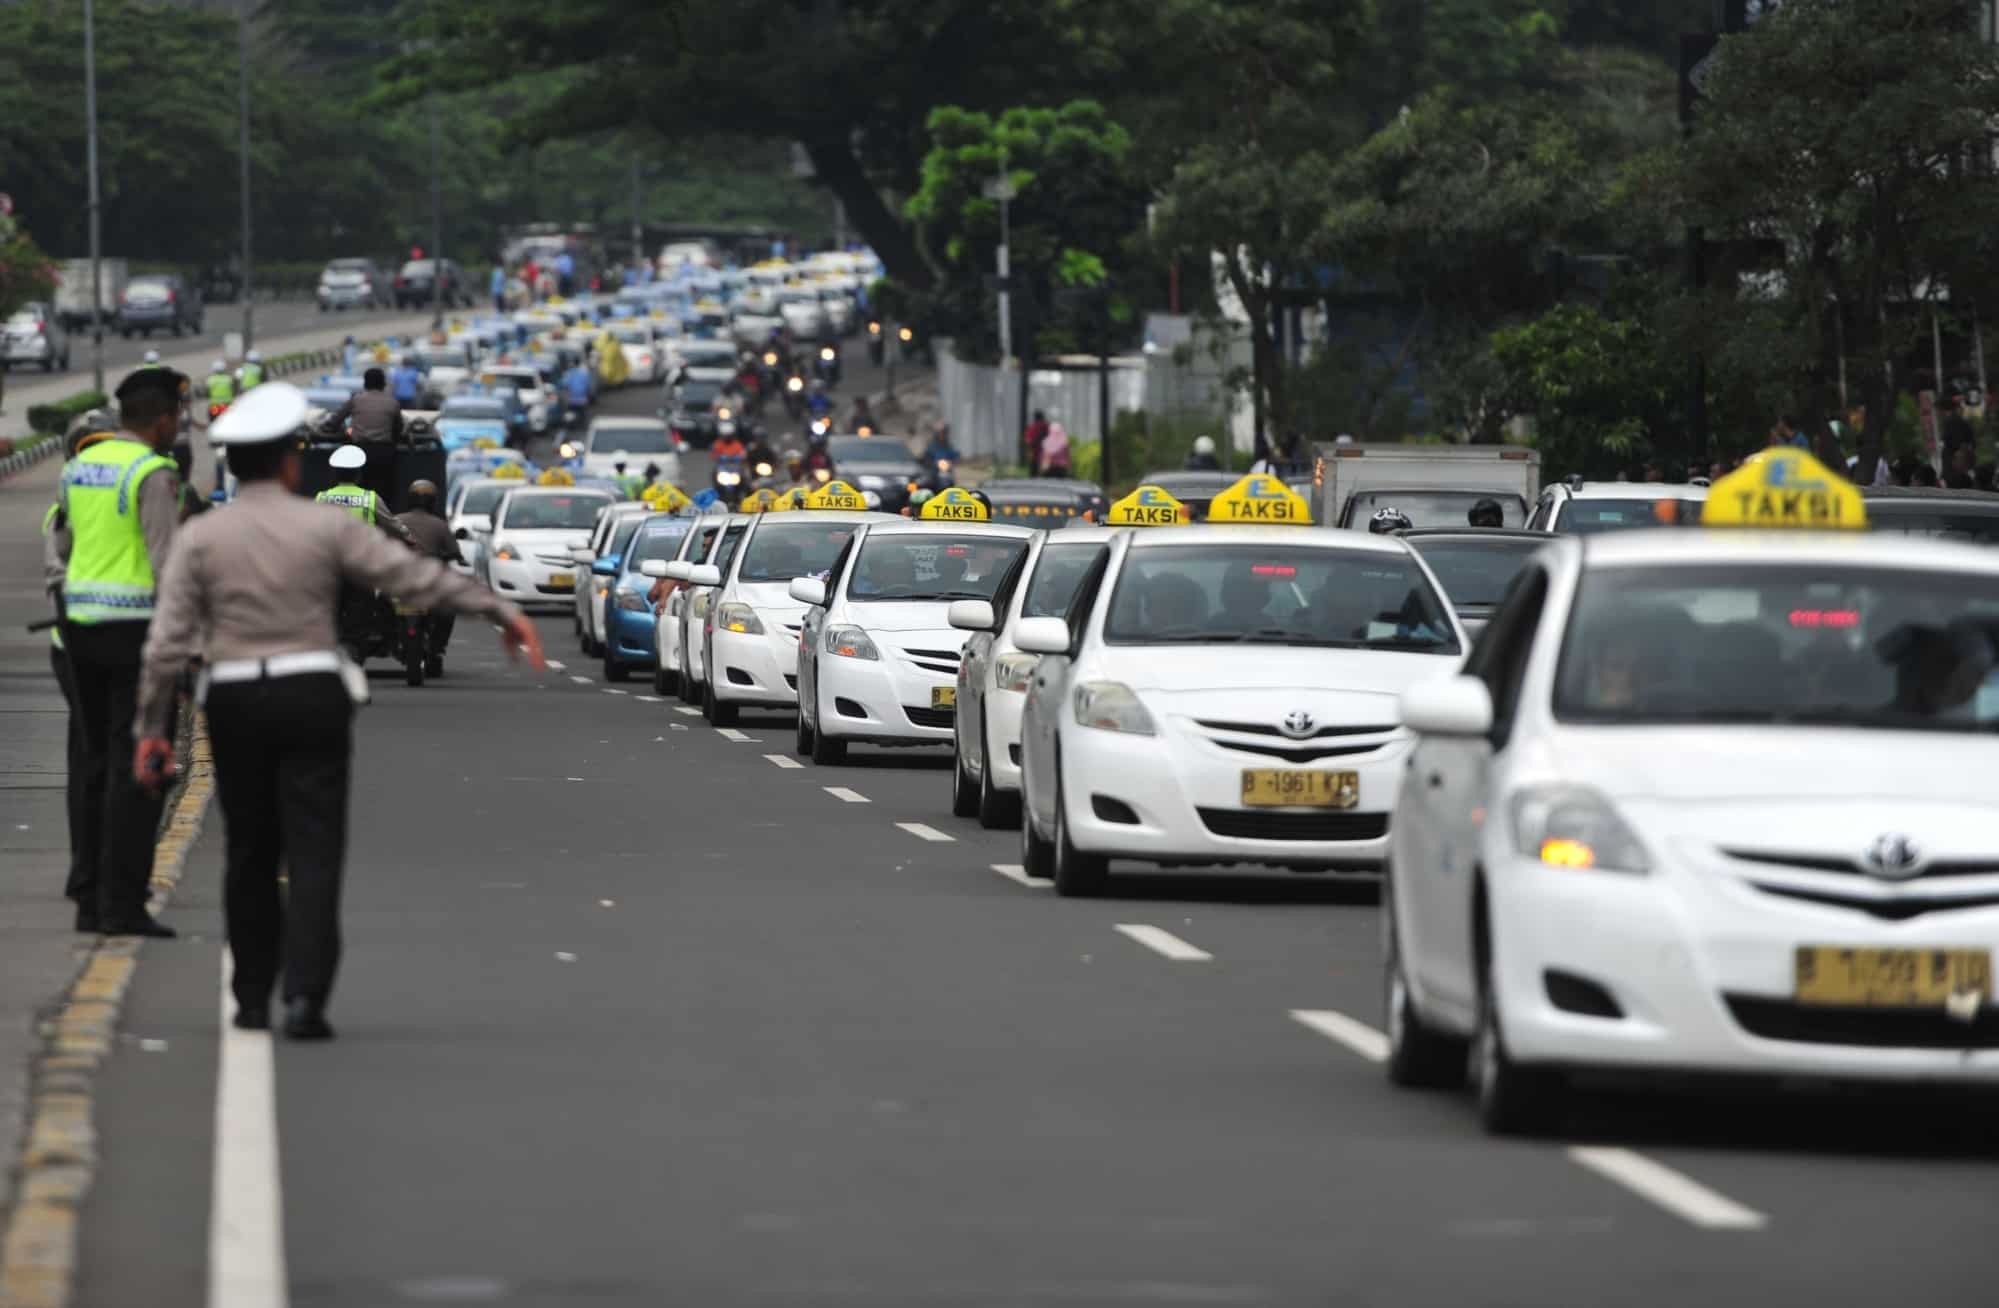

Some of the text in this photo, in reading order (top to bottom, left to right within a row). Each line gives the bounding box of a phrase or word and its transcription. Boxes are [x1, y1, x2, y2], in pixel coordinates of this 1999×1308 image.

[818, 496, 857, 508] TAKSI
[1228, 501, 1294, 519] TAKSI
[1736, 491, 1842, 519] TAKSI
[934, 505, 978, 518] TAKSI
[1123, 508, 1178, 523] TAKSI
[1242, 771, 1255, 793] B
